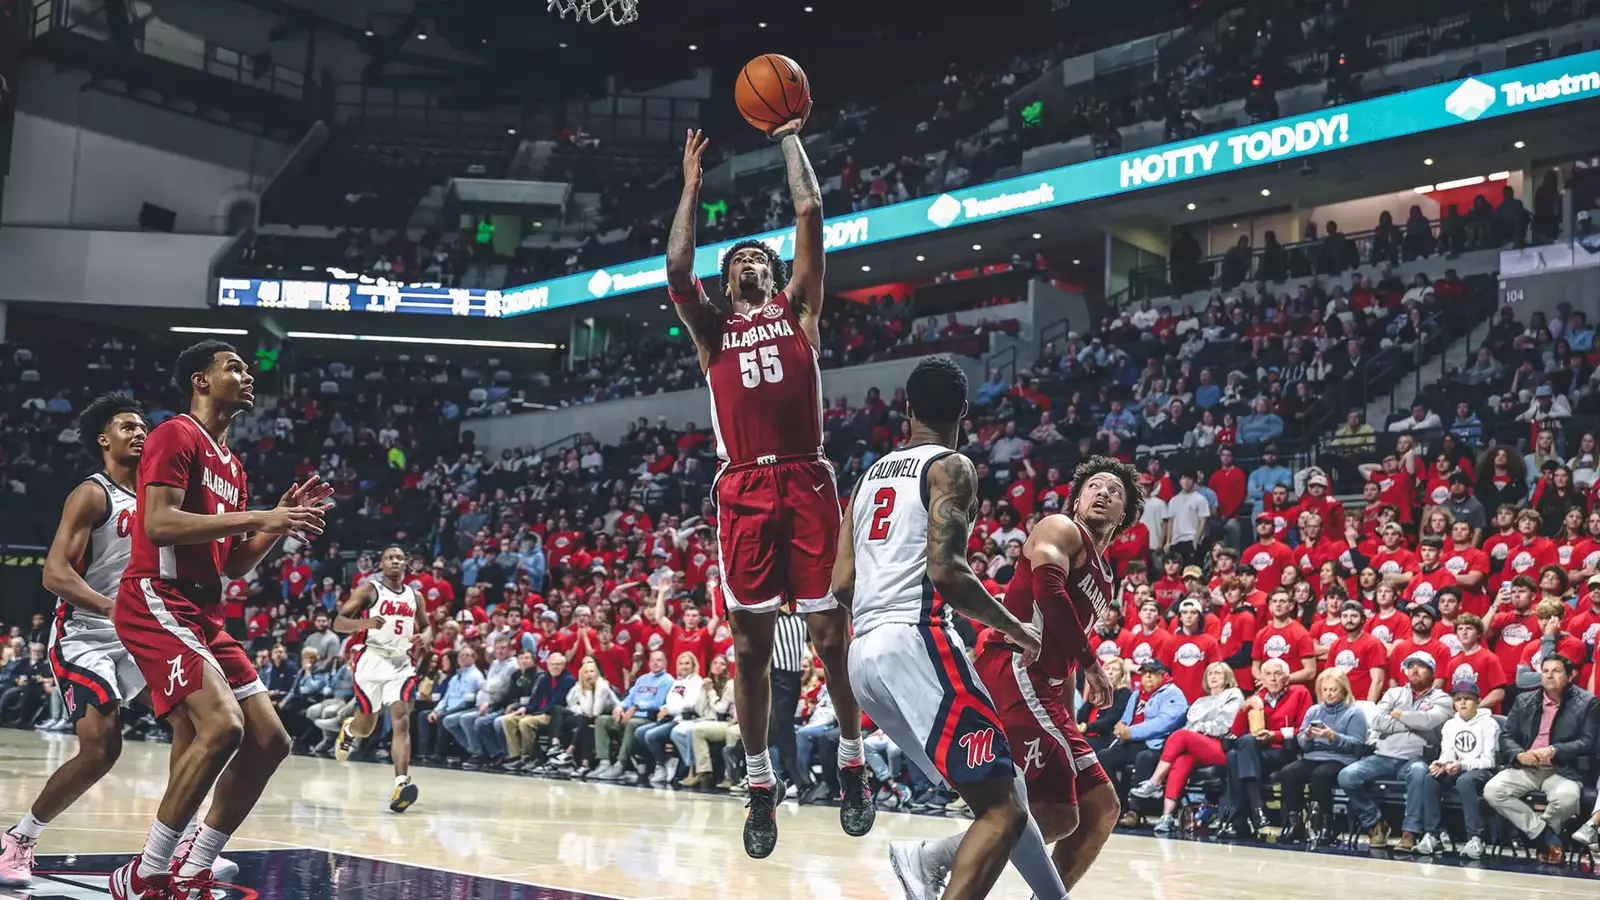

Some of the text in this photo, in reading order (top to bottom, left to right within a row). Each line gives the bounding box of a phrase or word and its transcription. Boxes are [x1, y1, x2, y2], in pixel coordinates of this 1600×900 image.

[1119, 113, 1349, 188] HOTTY TODDY!
[1505, 289, 1524, 303] 104
[721, 319, 795, 351] ALABAMA
[738, 344, 784, 389] 55
[757, 454, 777, 465] RTR
[867, 458, 920, 482] CALDWELL
[201, 466, 239, 508] ALABAMA
[868, 486, 897, 541] 2
[394, 619, 404, 635] 5
[1454, 730, 1477, 753] SIP
